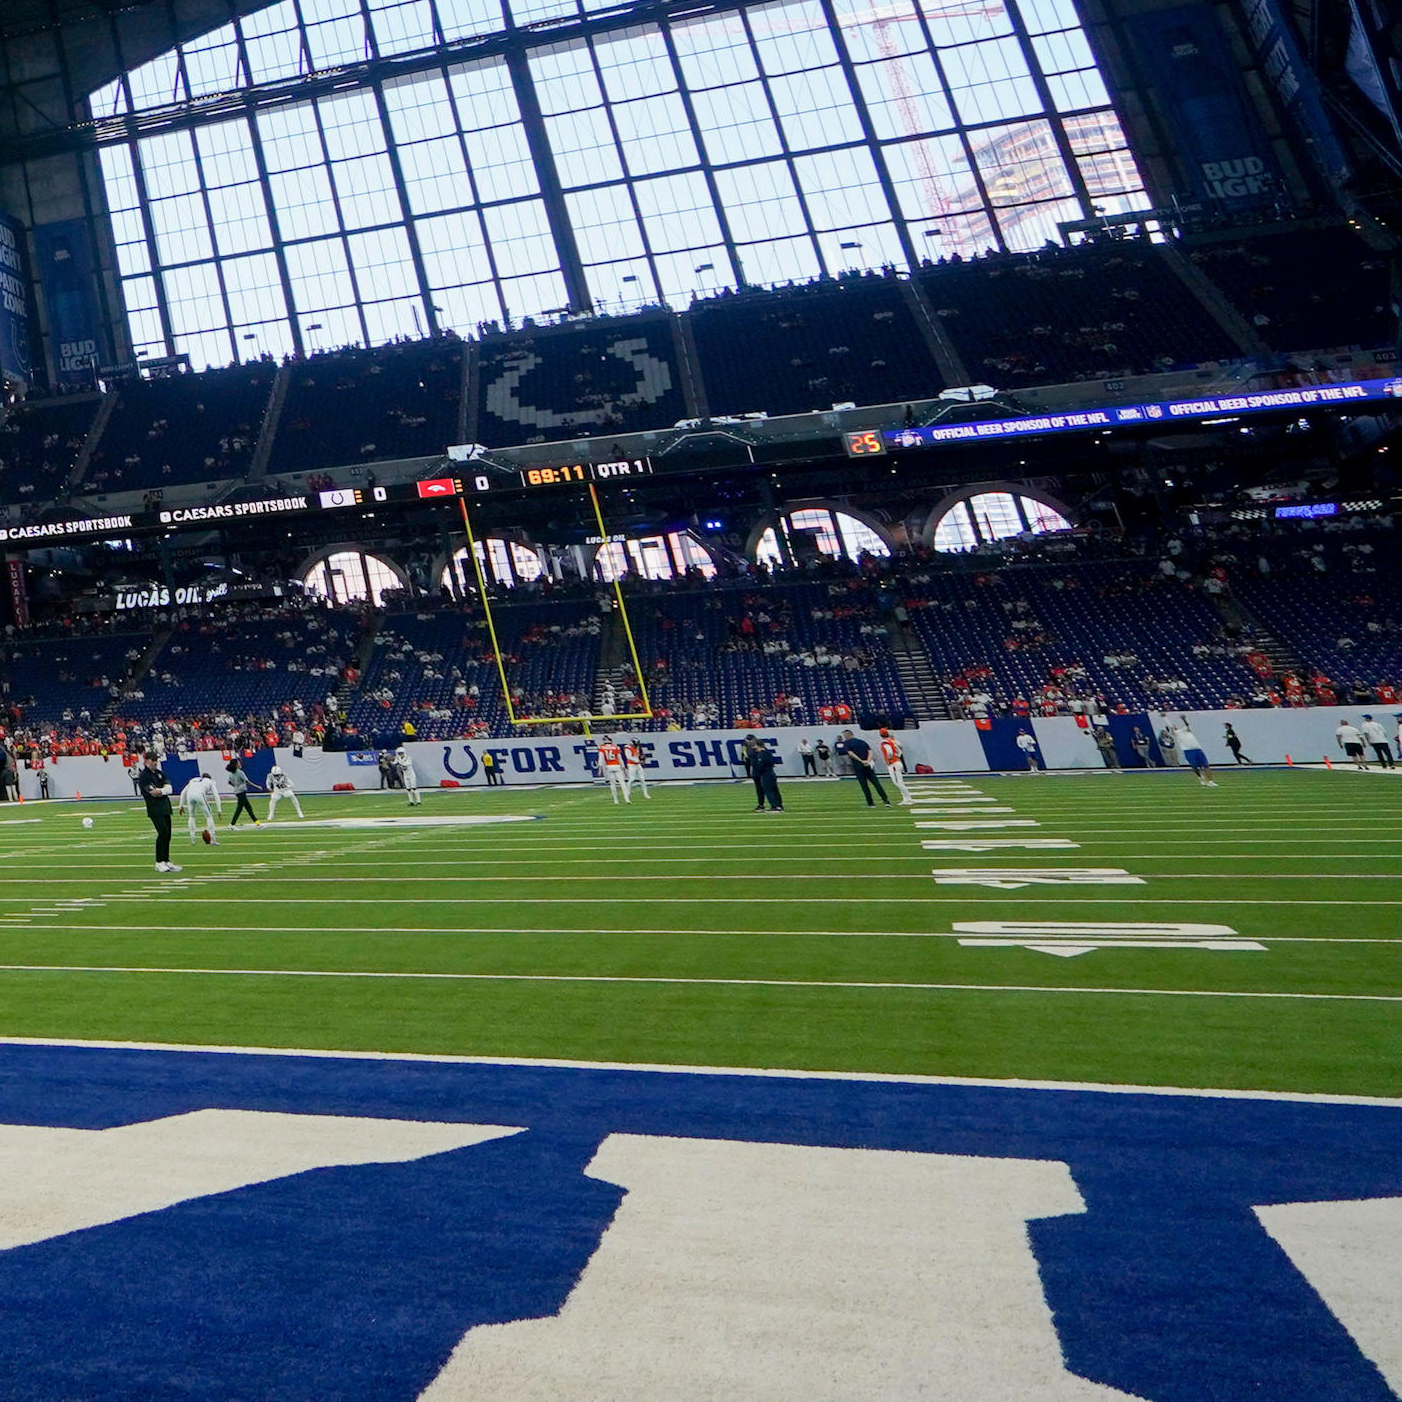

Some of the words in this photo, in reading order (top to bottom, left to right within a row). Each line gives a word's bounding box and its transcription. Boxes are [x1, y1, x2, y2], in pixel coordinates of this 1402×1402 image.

[1201, 157, 1265, 181] BUD
[1169, 401, 1219, 416] OFFICIAL
[1219, 398, 1246, 411] BEER
[1246, 393, 1302, 408] SPONSOR
[1302, 390, 1316, 402] OF
[1315, 388, 1341, 400] THE
[1339, 386, 1368, 398] NFL
[933, 426, 977, 440] OFFICIAL
[977, 423, 1003, 436] BEER
[1003, 419, 1051, 434] SPONSOR
[1051, 416, 1065, 428] OF
[1064, 414, 1088, 427] THE
[1087, 412, 1110, 424] NFL
[850, 433, 880, 454] 25
[527, 465, 584, 486] 69:11
[598, 462, 630, 478] QTR
[634, 460, 644, 474] 1
[373, 487, 387, 501] 0
[475, 477, 489, 491] 0
[173, 504, 234, 522] CAESARS
[234, 496, 308, 516] SPORTSBOOK
[9, 523, 65, 539] CAESARS
[66, 515, 133, 533] SPORTSBOOK
[116, 588, 170, 610] LUCAS
[175, 586, 203, 605] OIL
[604, 749, 615, 761] 16
